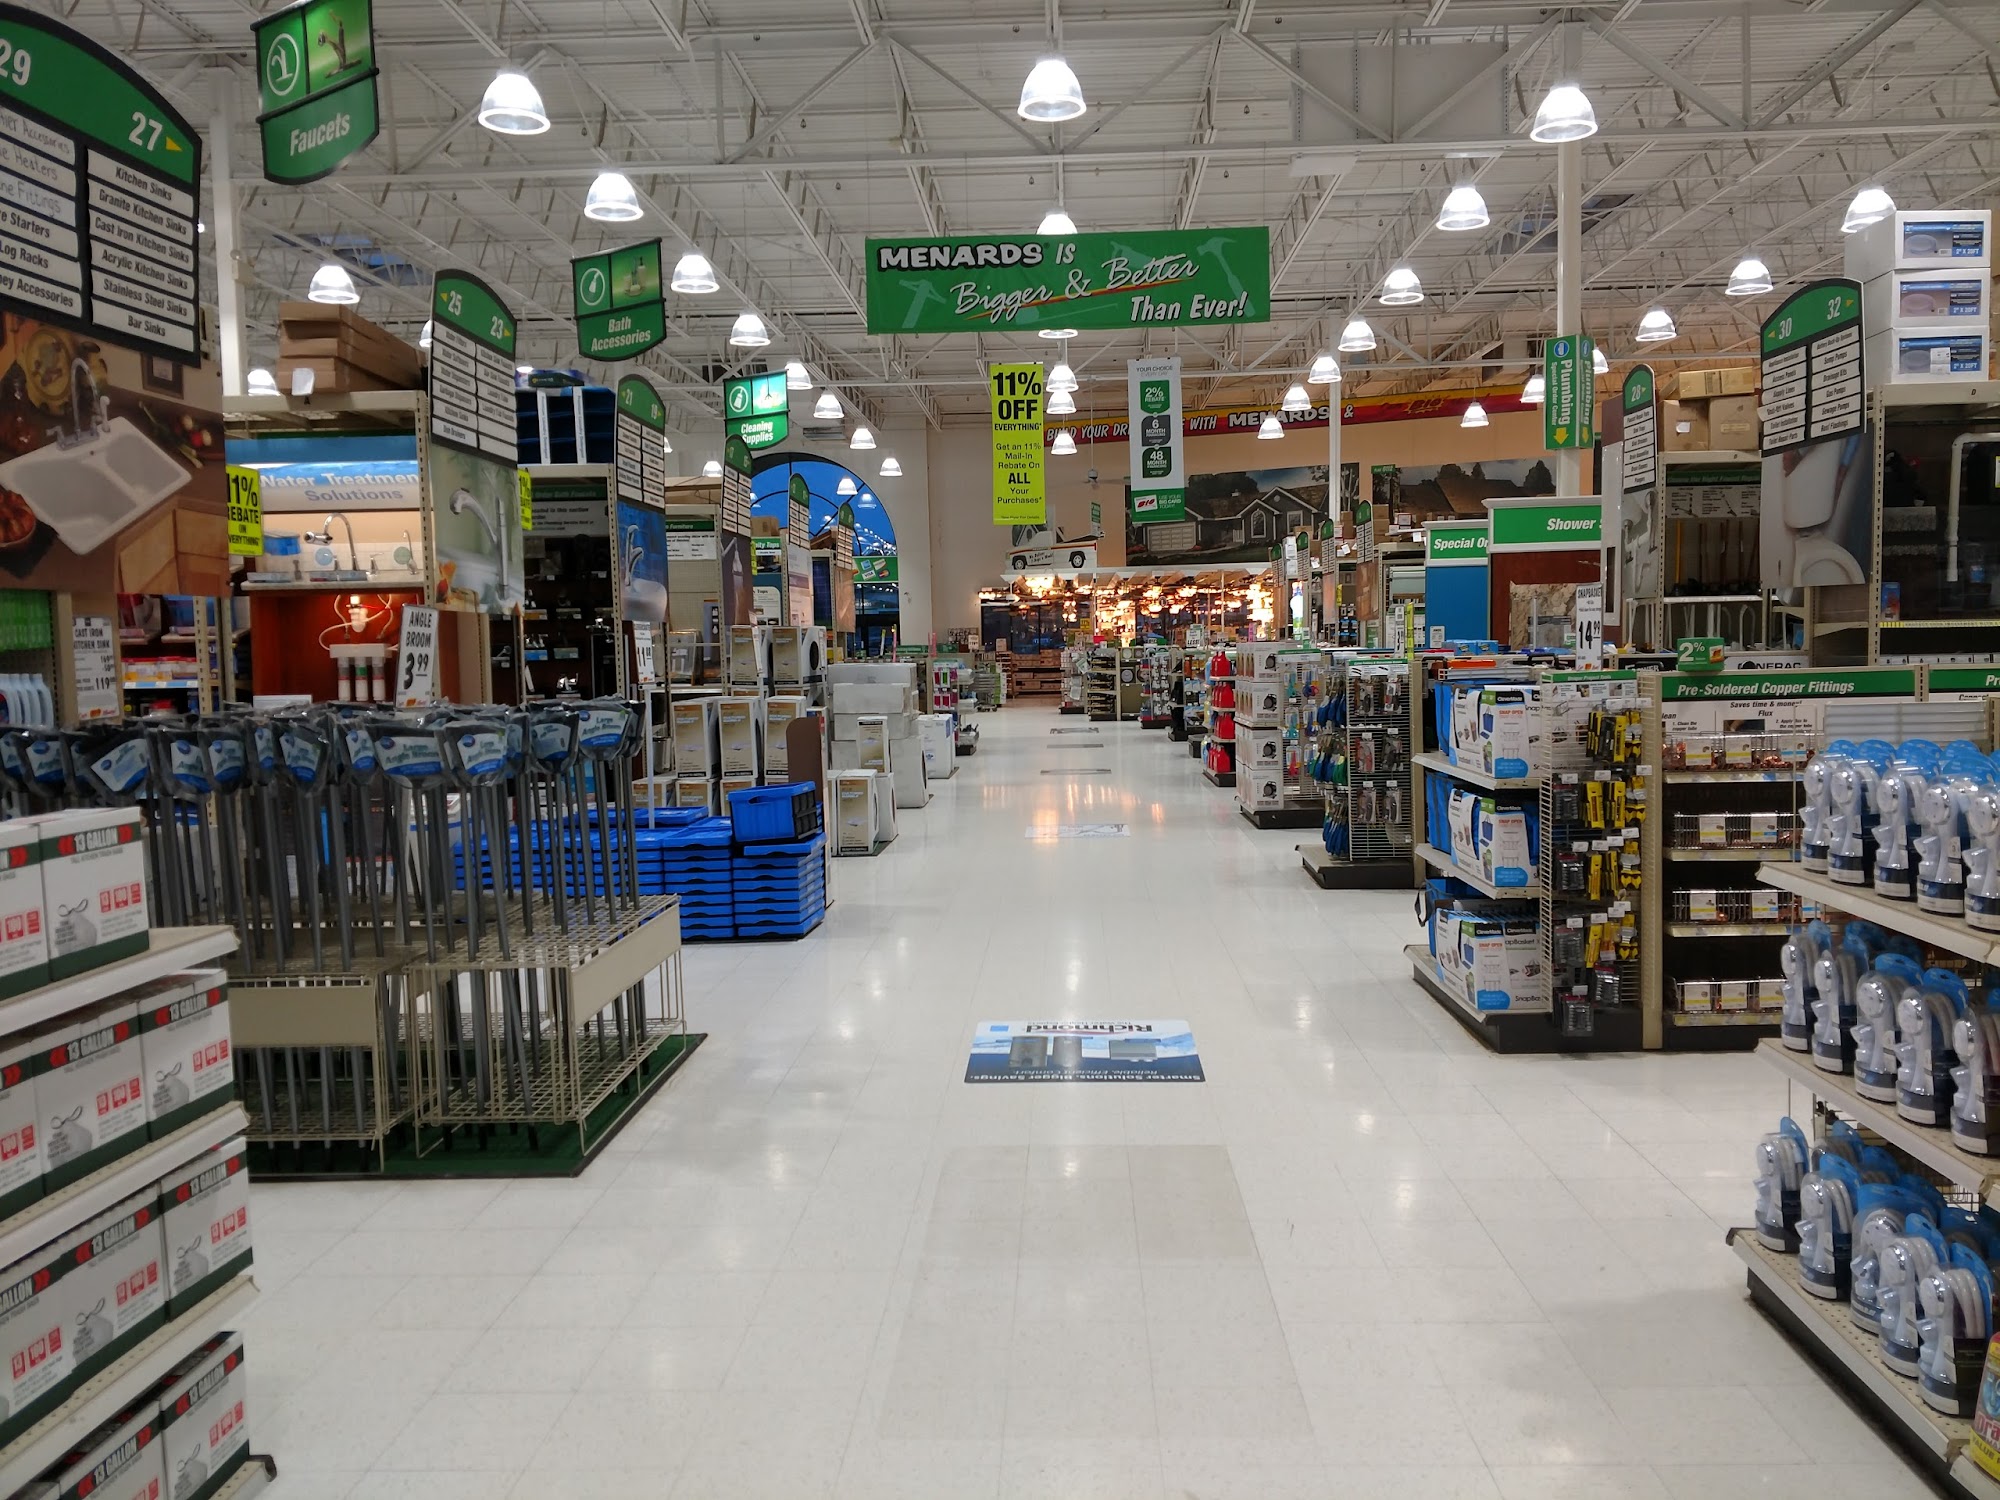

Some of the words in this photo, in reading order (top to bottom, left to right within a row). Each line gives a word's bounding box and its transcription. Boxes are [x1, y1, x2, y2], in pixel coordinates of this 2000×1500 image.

[128, 111, 163, 151] 27
[290, 113, 350, 157] Faucets
[14, 145, 58, 180] Heaters
[115, 166, 148, 189] Kitchen
[150, 182, 172, 200] Sinks
[18, 181, 61, 217] Fittings
[99, 189, 130, 211] Granite
[133, 203, 163, 226] Kitchen
[166, 217, 187, 235] Sinks
[10, 212, 50, 238] Starters
[95, 216, 115, 235] Cast
[117, 227, 134, 241] Iron
[136, 236, 167, 255] Kitchen
[169, 246, 189, 264] Sinks
[20, 247, 49, 268] Racks
[879, 242, 1043, 271] MENARDS
[1055, 243, 1076, 264] IS
[102, 249, 133, 270] Acrylic
[134, 260, 165, 281] Kitchen
[167, 273, 188, 290] Sinks
[17, 278, 73, 307] Accessories
[104, 279, 142, 302] Stainless
[145, 292, 164, 309] Steel
[167, 300, 187, 317] Sinks
[950, 281, 1053, 323] Bigger
[1065, 268, 1091, 299] &
[1101, 253, 1199, 290] Better
[448, 290, 462, 316] 25
[1130, 295, 1181, 321] Than
[1189, 290, 1248, 319] Ever!
[1827, 296, 1841, 320] 32
[128, 315, 142, 329] Bar
[144, 320, 166, 337] Sinks
[490, 316, 504, 340] 23
[608, 317, 631, 333] Bath
[1779, 317, 1792, 340] 30
[591, 330, 651, 352] Accessories
[993, 371, 1042, 396] 11%
[1145, 387, 1163, 398] 2%
[1558, 359, 1573, 425] Plumbing
[1632, 385, 1641, 402] 28
[998, 399, 1038, 420] OFF
[1190, 416, 1217, 430] WITH
[1229, 406, 1330, 427] MEARDS
[1344, 404, 1353, 418] &
[741, 421, 773, 434] Cleaning
[1082, 424, 1109, 438] YOUR
[1152, 419, 1159, 428] 6
[742, 432, 773, 445] Supplies
[1150, 451, 1163, 460] 48
[321, 472, 418, 486] Treatmen
[1008, 473, 1031, 484] ALL
[305, 489, 404, 502] Solutions
[1010, 487, 1029, 495] Your
[1547, 517, 1596, 530] Shower
[766, 541, 779, 549] Tops
[1434, 537, 1474, 550] Special
[409, 611, 432, 628] ANGLE
[75, 628, 87, 637] CAST
[89, 628, 103, 637] IRON
[406, 631, 431, 648] BROOM
[1579, 621, 1592, 649] 14
[1594, 621, 1600, 634] 99
[1679, 641, 1705, 662] 2%
[404, 652, 414, 689] 3
[417, 653, 428, 671] 99
[96, 677, 110, 690] 119
[1677, 682, 1759, 696] Pre-Soldered
[1761, 682, 1805, 698] Copper
[1808, 681, 1855, 697] Fittings
[74, 833, 86, 853] 13
[86, 827, 118, 851] GALLON
[170, 1004, 179, 1020] 13
[180, 993, 207, 1018] GALLON
[1026, 1024, 1152, 1032] Richmond
[68, 1042, 79, 1061] 13
[80, 1027, 115, 1057] GALLON
[190, 1177, 200, 1196] 13
[200, 1163, 227, 1191] GALLON
[92, 1235, 102, 1255] 13
[103, 1215, 136, 1247] GALLON
[189, 1385, 199, 1405] 13
[199, 1362, 225, 1398] GALLON
[93, 1466, 104, 1486] 13
[106, 1436, 137, 1477] GALLON
